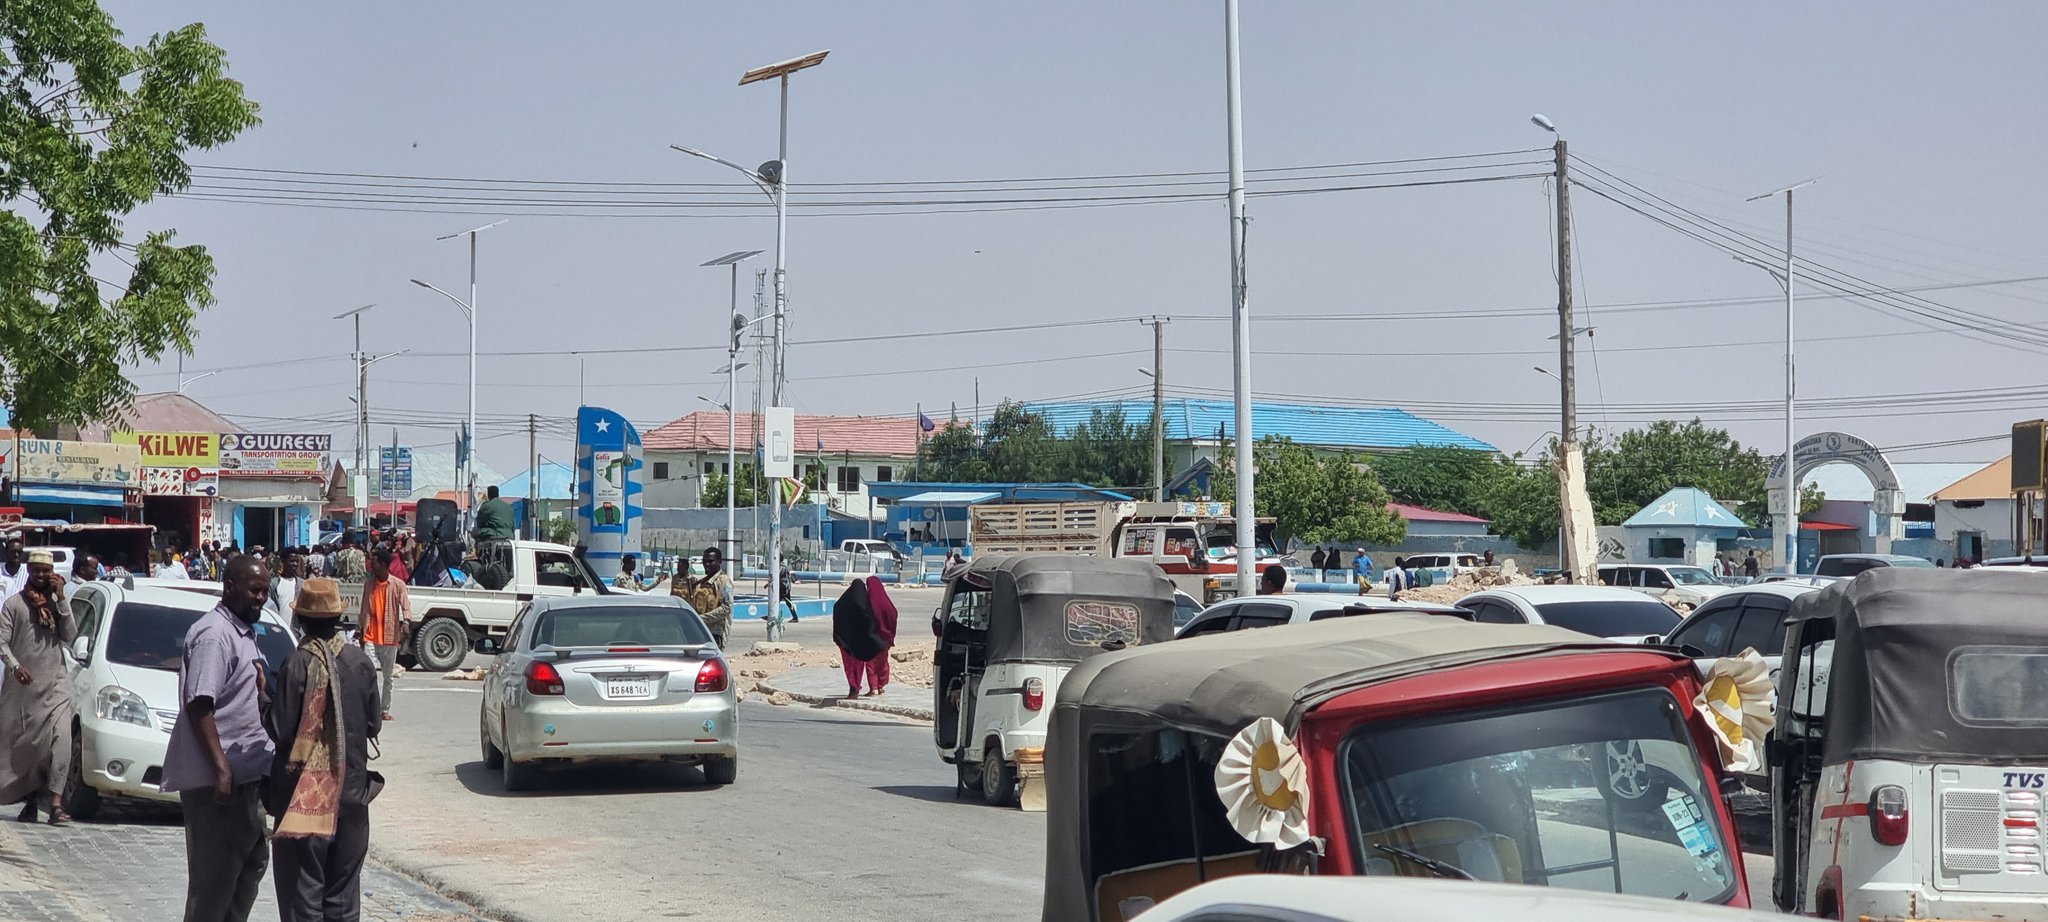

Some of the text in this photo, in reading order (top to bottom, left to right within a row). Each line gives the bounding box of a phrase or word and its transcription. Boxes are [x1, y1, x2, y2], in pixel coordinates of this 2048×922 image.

[241, 451, 321, 459] TRANSPORTATION GROUP
[2003, 772, 2045, 788] TVS
